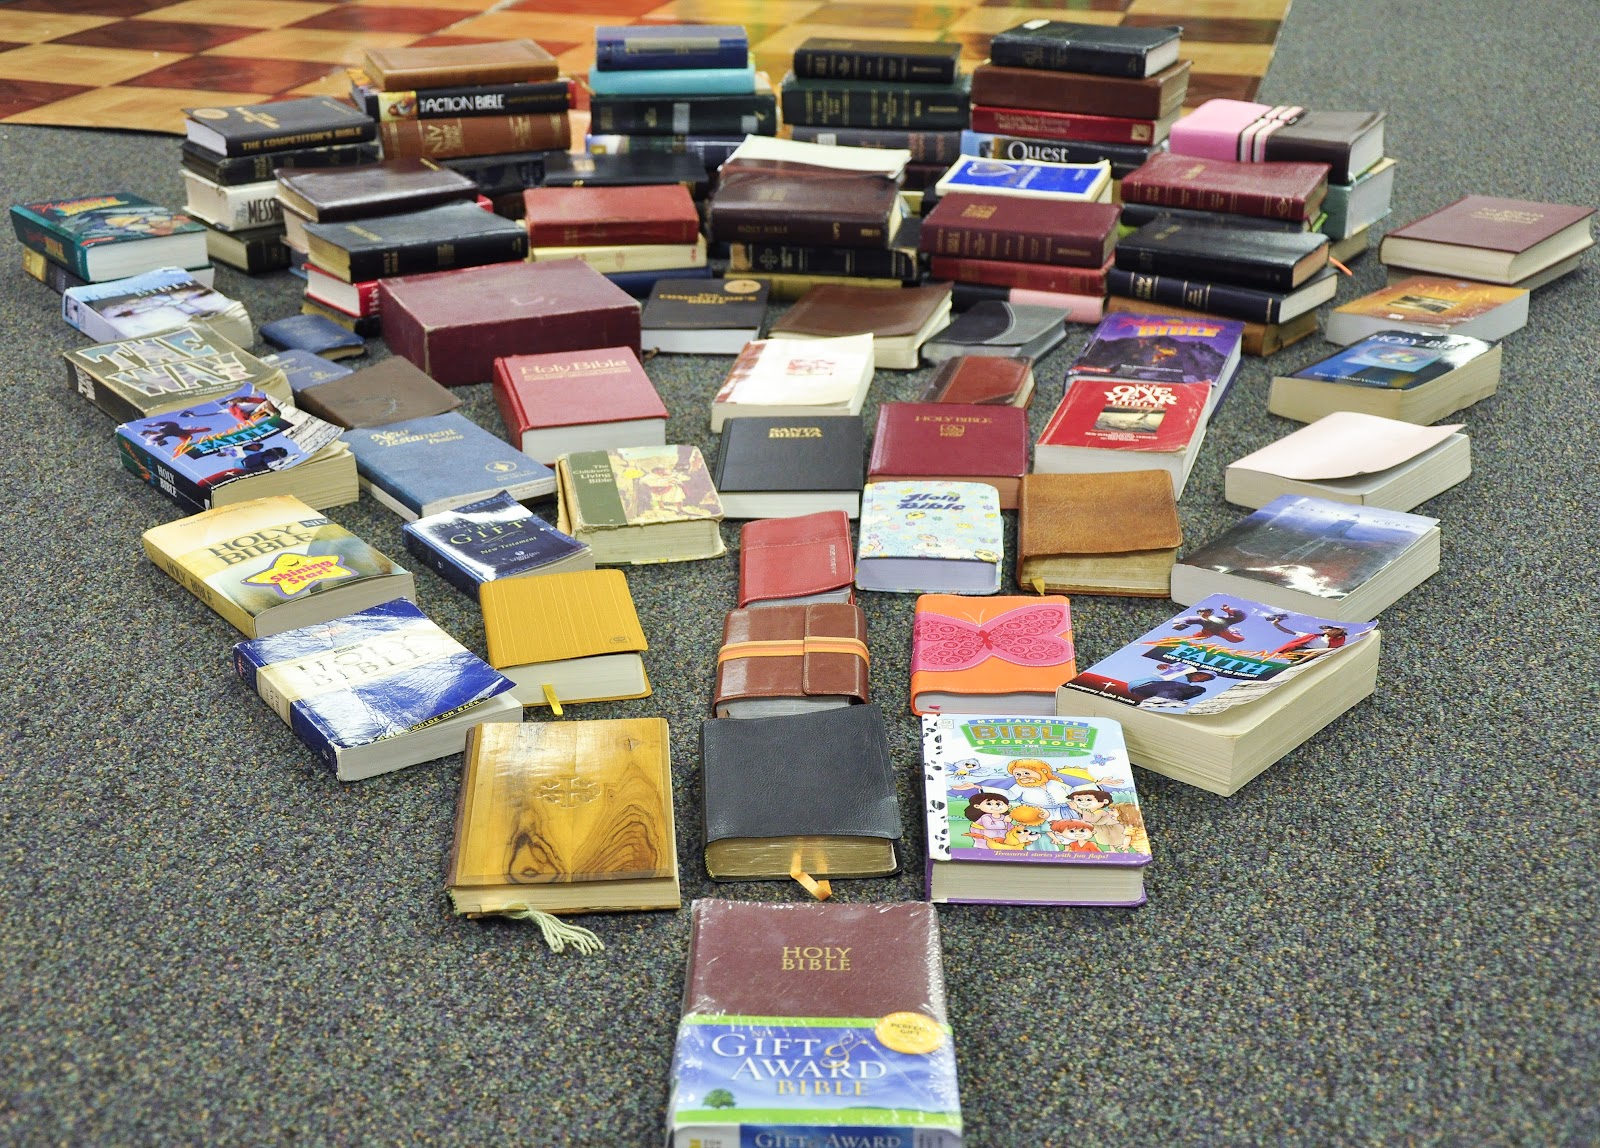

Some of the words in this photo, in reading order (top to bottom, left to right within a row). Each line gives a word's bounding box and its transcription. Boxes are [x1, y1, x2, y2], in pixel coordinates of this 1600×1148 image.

[426, 96, 474, 112] ACTION
[475, 94, 504, 110] BIBLE
[241, 140, 261, 150] THE
[335, 127, 362, 138] BIBLE
[1007, 141, 1070, 162] Quest
[1137, 325, 1220, 338] BIBLE
[76, 327, 220, 372] THE
[105, 352, 257, 397] WAY
[520, 363, 570, 374] Holy
[571, 360, 628, 371] Bible
[1104, 391, 1178, 405] YEAR
[1112, 384, 1172, 398] ONE
[193, 422, 277, 452] FAITH
[371, 429, 409, 442] New
[379, 428, 457, 447] Testament
[157, 464, 175, 485] HOLY
[160, 477, 178, 498] BIBLE
[900, 492, 961, 502] Holy
[896, 502, 966, 511] Bible
[304, 518, 328, 528] NIV
[450, 520, 524, 545] GIFT
[208, 525, 296, 556] HOLY
[220, 532, 315, 566] BIBLE
[480, 547, 498, 555] New
[499, 536, 538, 549] Testament
[270, 560, 334, 582] Shining
[287, 567, 332, 585] Star!
[165, 560, 186, 584] HOLY
[190, 578, 212, 602] BIBLE
[1168, 644, 1273, 675] FAITH
[412, 715, 440, 731] GUIDE
[442, 710, 456, 719] ON
[456, 699, 481, 713] BACK
[1006, 718, 1079, 726] FAVORITE
[970, 724, 1090, 743] BIBLE
[976, 739, 1088, 748] STORYBOOK
[782, 946, 852, 959] HOLY
[781, 958, 851, 971] BIBLE
[899, 1028, 920, 1036] GIFT
[711, 1033, 821, 1058] GIFT
[820, 1034, 868, 1069] &
[730, 1057, 887, 1080] AWARD
[776, 1080, 869, 1096] BIBLE
[754, 1132, 808, 1148] GIFT
[825, 1133, 900, 1148] AWARD
